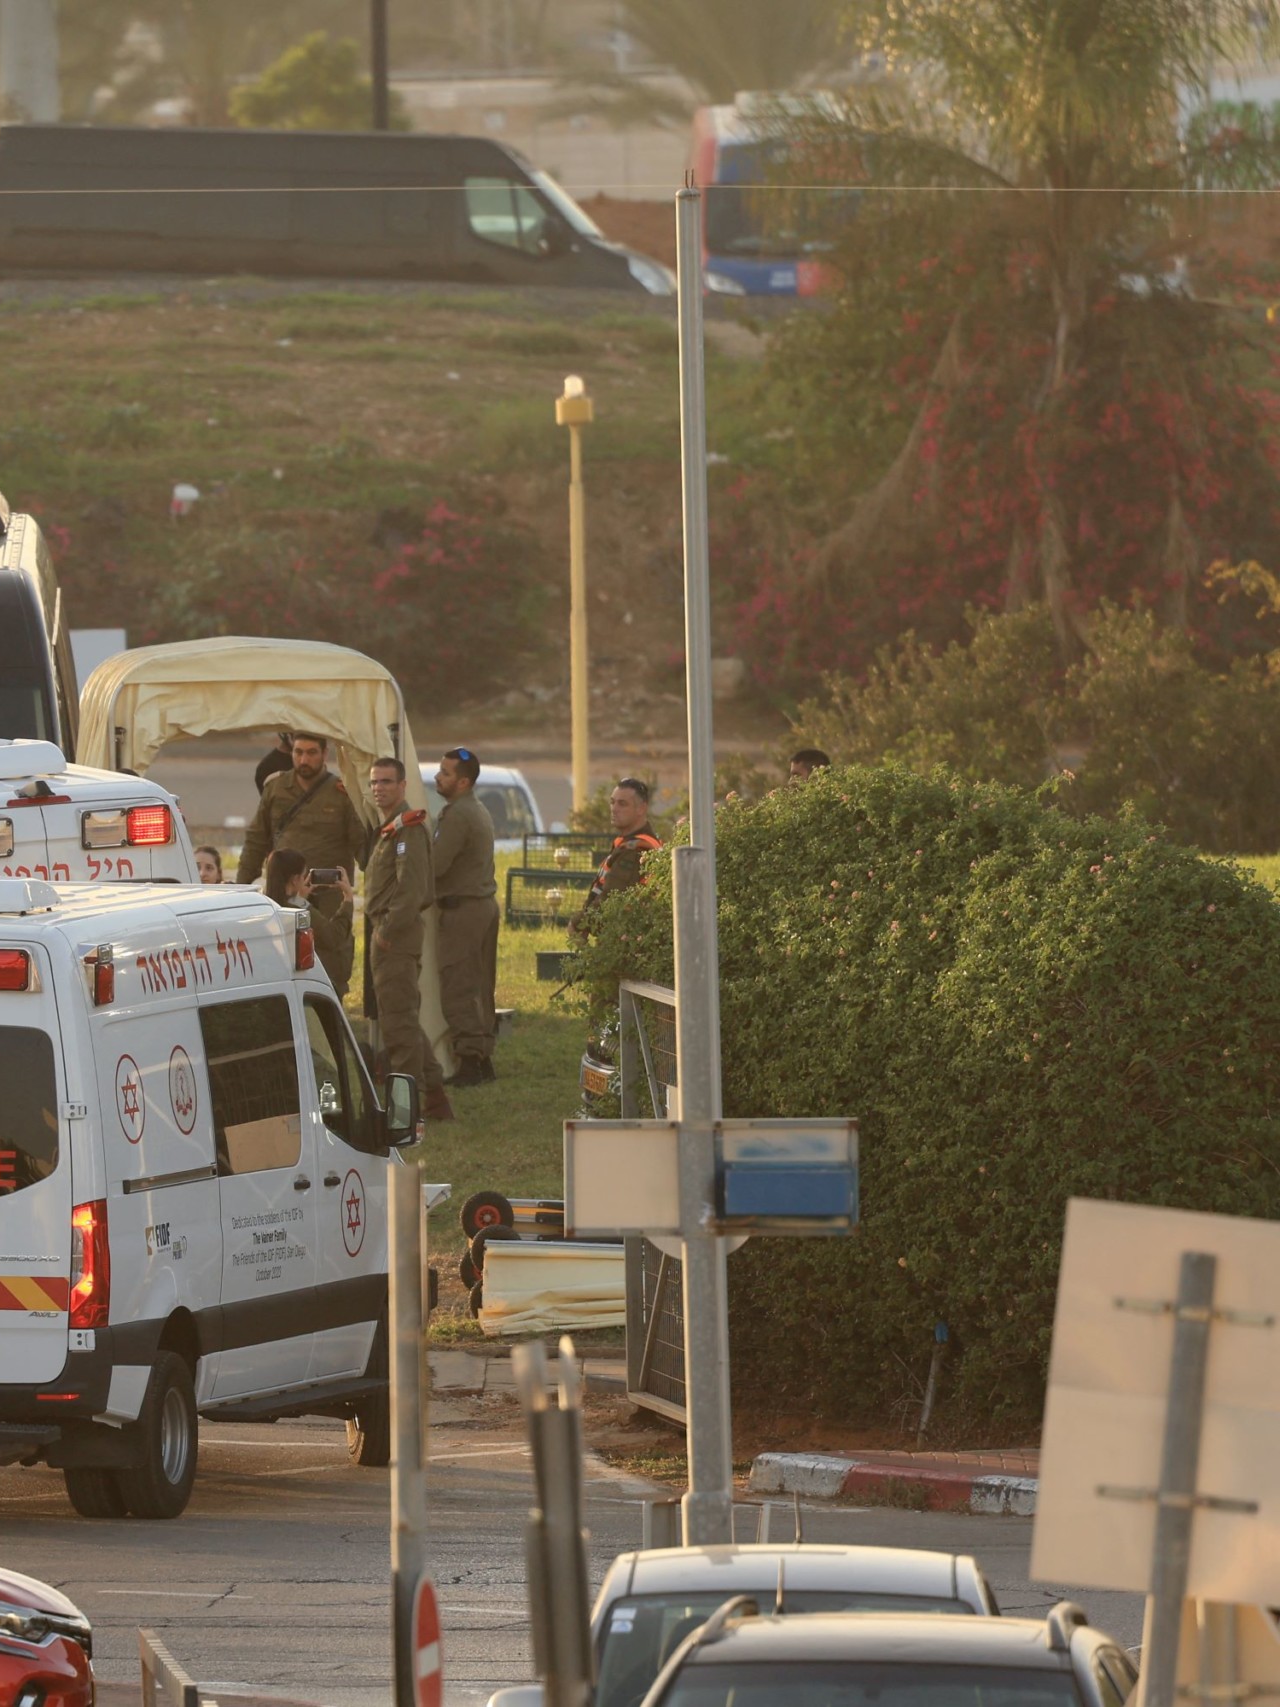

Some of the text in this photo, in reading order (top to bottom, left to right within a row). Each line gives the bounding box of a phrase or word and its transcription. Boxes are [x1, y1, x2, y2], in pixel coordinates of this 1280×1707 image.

[87, 854, 134, 881] חיל
[136, 930, 254, 995] חיל הרפואה
[155, 1222, 170, 1248] FIDF
